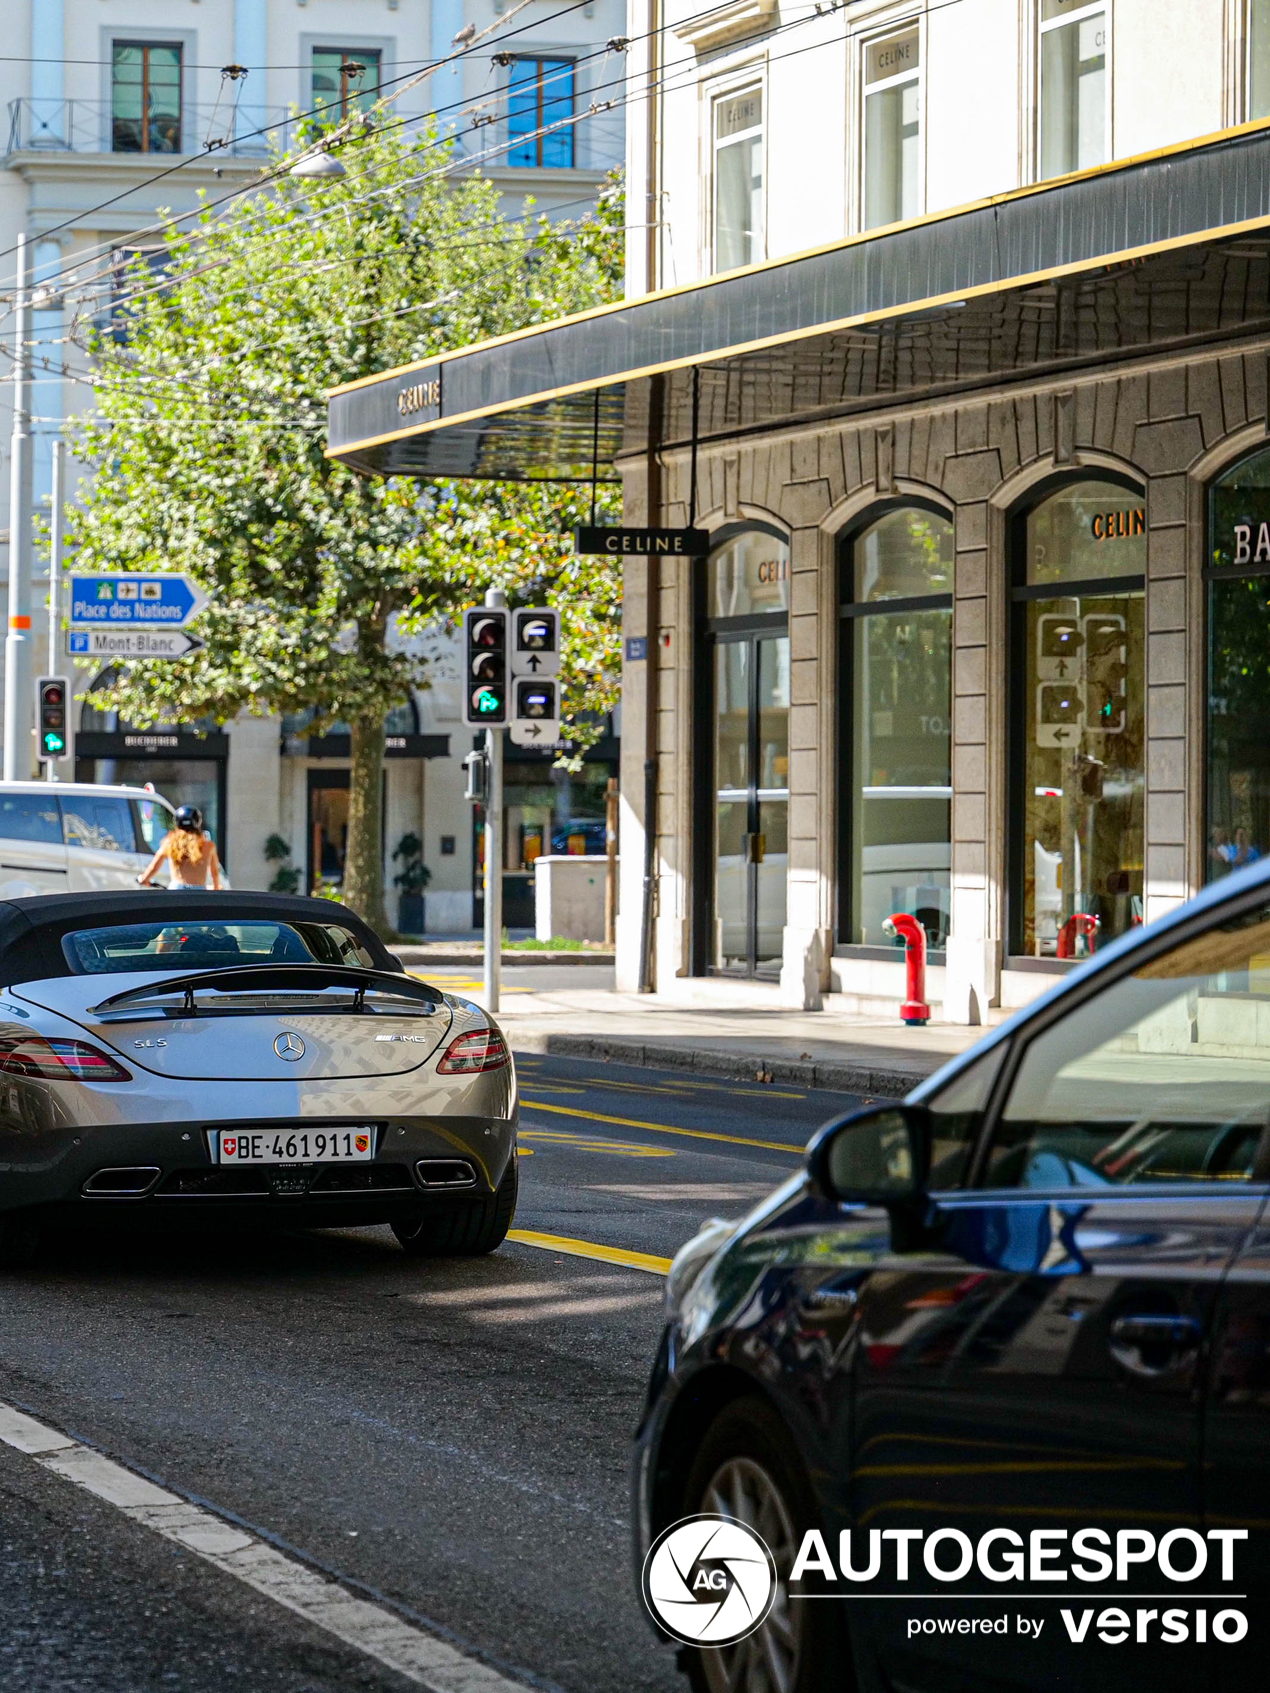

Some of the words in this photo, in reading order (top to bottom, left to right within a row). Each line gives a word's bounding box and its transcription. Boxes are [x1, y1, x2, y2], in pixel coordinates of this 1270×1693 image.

[879, 45, 910, 68] CELINE
[728, 102, 754, 123] CELINE
[397, 379, 440, 415] CELINE
[605, 535, 683, 552] CELINE
[73, 601, 107, 618] Place
[109, 602, 130, 618] des
[134, 602, 182, 619] Nations
[93, 634, 176, 651] Mont-Blanc
[133, 1037, 168, 1049] SLS
[391, 1034, 426, 1043] AMG
